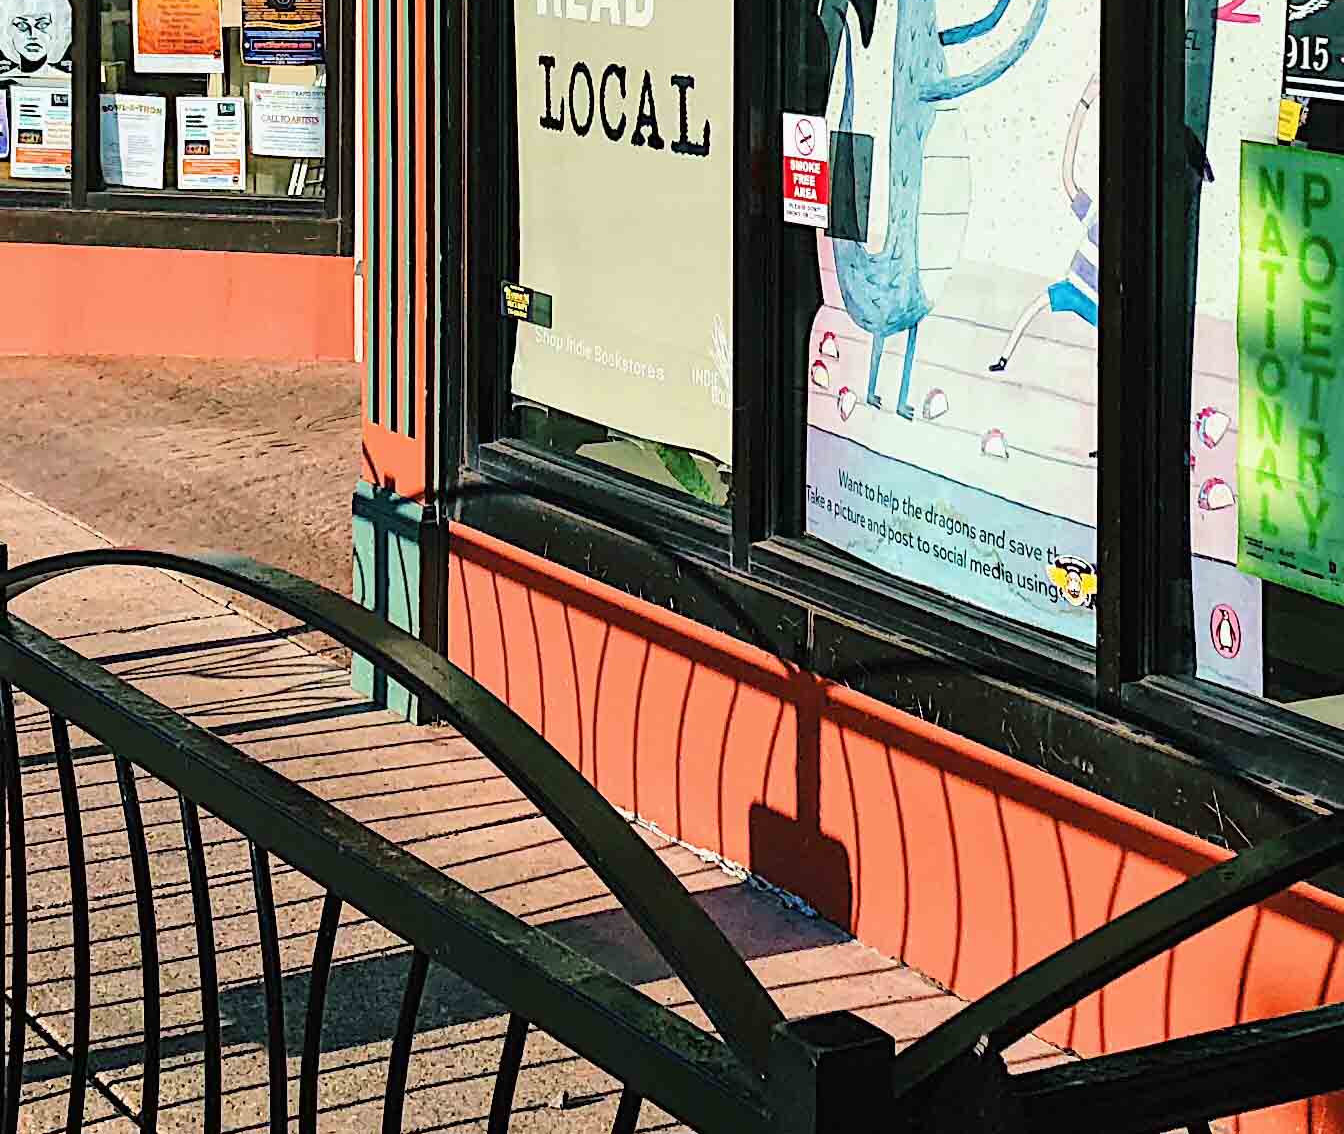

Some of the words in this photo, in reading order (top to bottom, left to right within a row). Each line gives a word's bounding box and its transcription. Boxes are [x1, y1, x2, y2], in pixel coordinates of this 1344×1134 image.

[539, 55, 710, 157] LOCAL
[789, 159, 821, 174] SMOKE
[792, 172, 816, 186] FREE
[794, 186, 818, 201] AREA
[535, 328, 564, 353] Shop
[567, 337, 593, 360] Indie
[594, 345, 665, 381] Bookstores
[1256, 167, 1288, 537] NATIONAL
[1297, 172, 1336, 550] POETRY
[806, 484, 825, 509] Take
[826, 496, 832, 513] a
[834, 499, 865, 530] picture
[867, 517, 886, 538] and
[888, 528, 915, 550] post
[917, 538, 930, 555] to
[933, 543, 967, 569] social
[970, 557, 1014, 584] media
[1017, 574, 1059, 603] using
[838, 468, 864, 495] Want
[865, 485, 875, 501] to
[877, 484, 900, 514] help
[902, 498, 922, 521] the
[924, 505, 977, 539] dragons
[979, 529, 1005, 549] and
[1008, 539, 1043, 562] save
